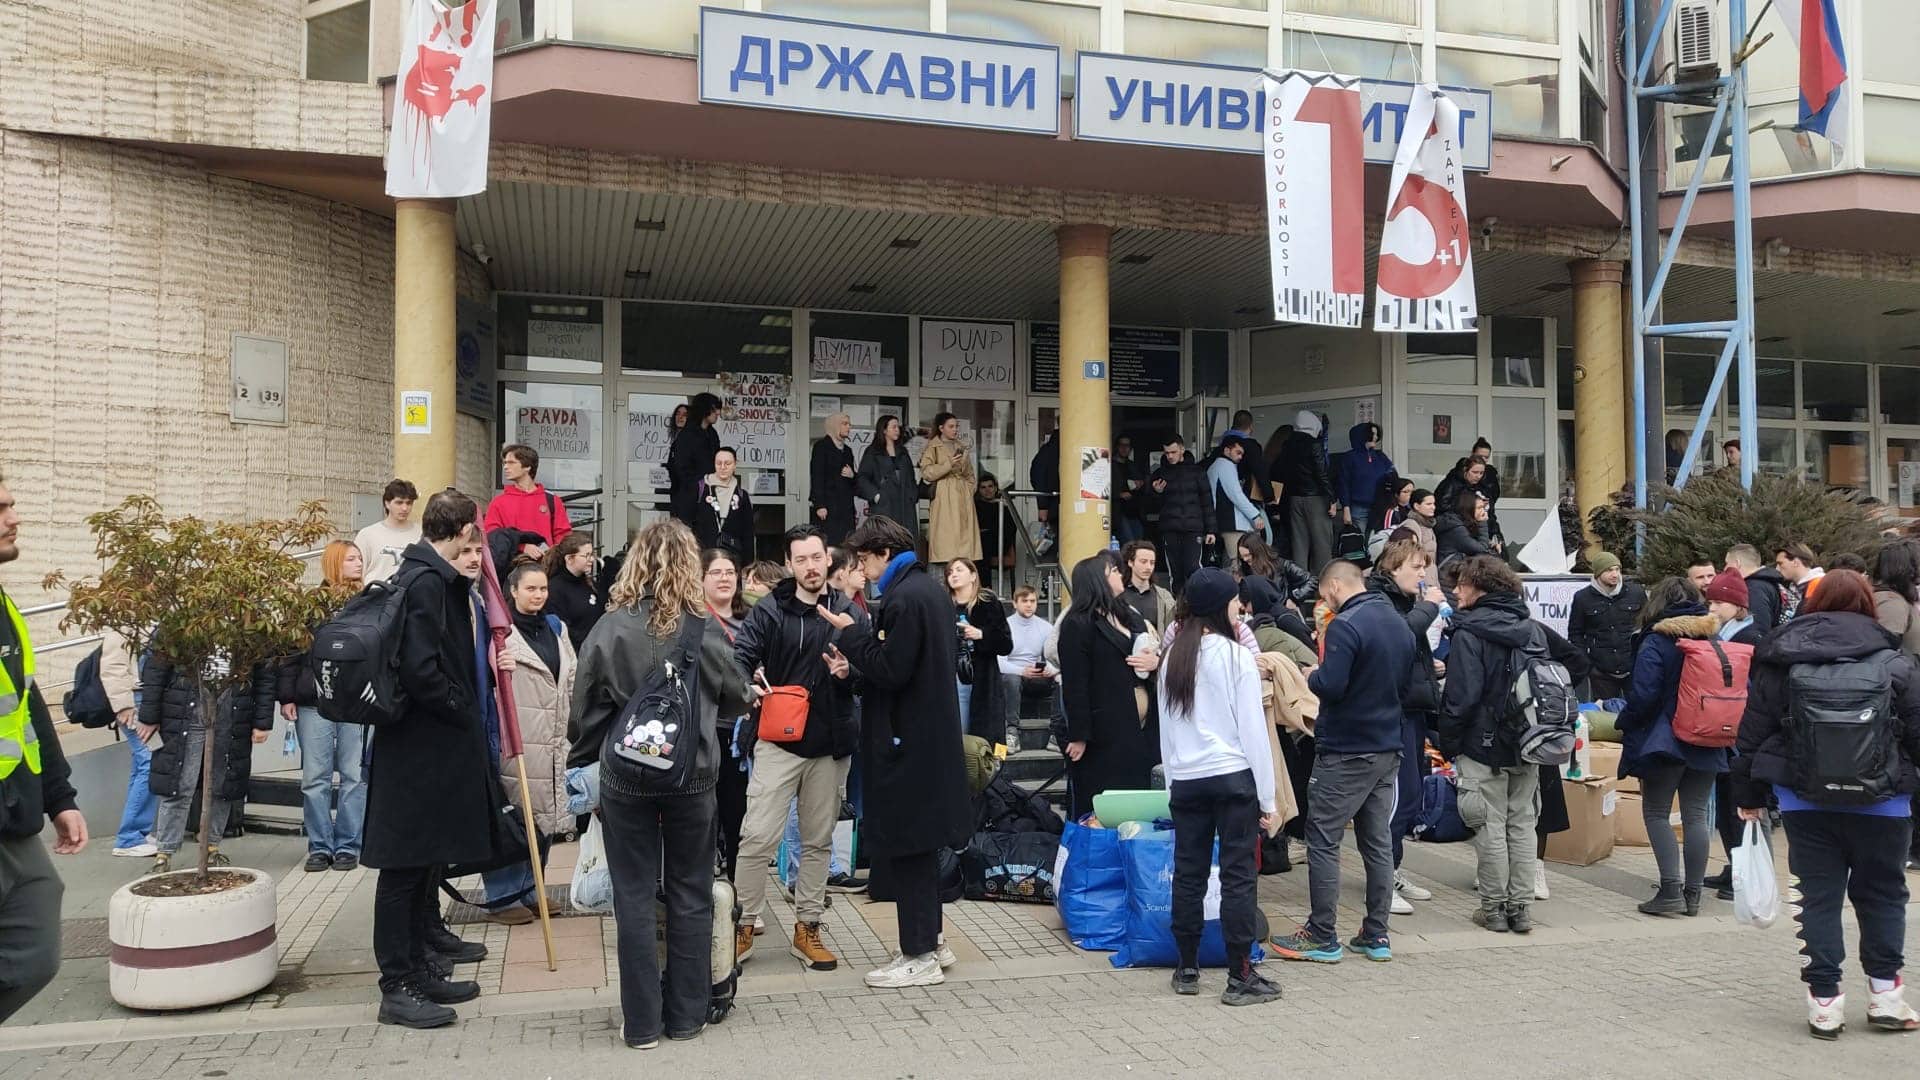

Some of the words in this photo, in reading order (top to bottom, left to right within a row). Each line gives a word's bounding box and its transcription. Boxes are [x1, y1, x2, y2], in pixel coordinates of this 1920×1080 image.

[730, 35, 1036, 110] ДРЖАВНИ
[1272, 97, 1290, 278] ODGOVORNOST
[1276, 287, 1363, 327] BLOKADA
[1376, 298, 1477, 331] DUNP
[941, 327, 1003, 351] DUNP
[964, 351, 976, 365] U
[933, 365, 1012, 383] BLOKADI
[1092, 363, 1100, 377] 9
[740, 384, 773, 396] LOVE
[725, 396, 738, 407] NE
[518, 407, 578, 427] PRAVDA
[738, 408, 775, 421] SNOVE
[518, 426, 531, 437] JE
[540, 425, 579, 438] PRAVDA
[643, 430, 658, 443] KO
[538, 439, 590, 454] PRIVILEGIJA
[739, 434, 755, 445] JE
